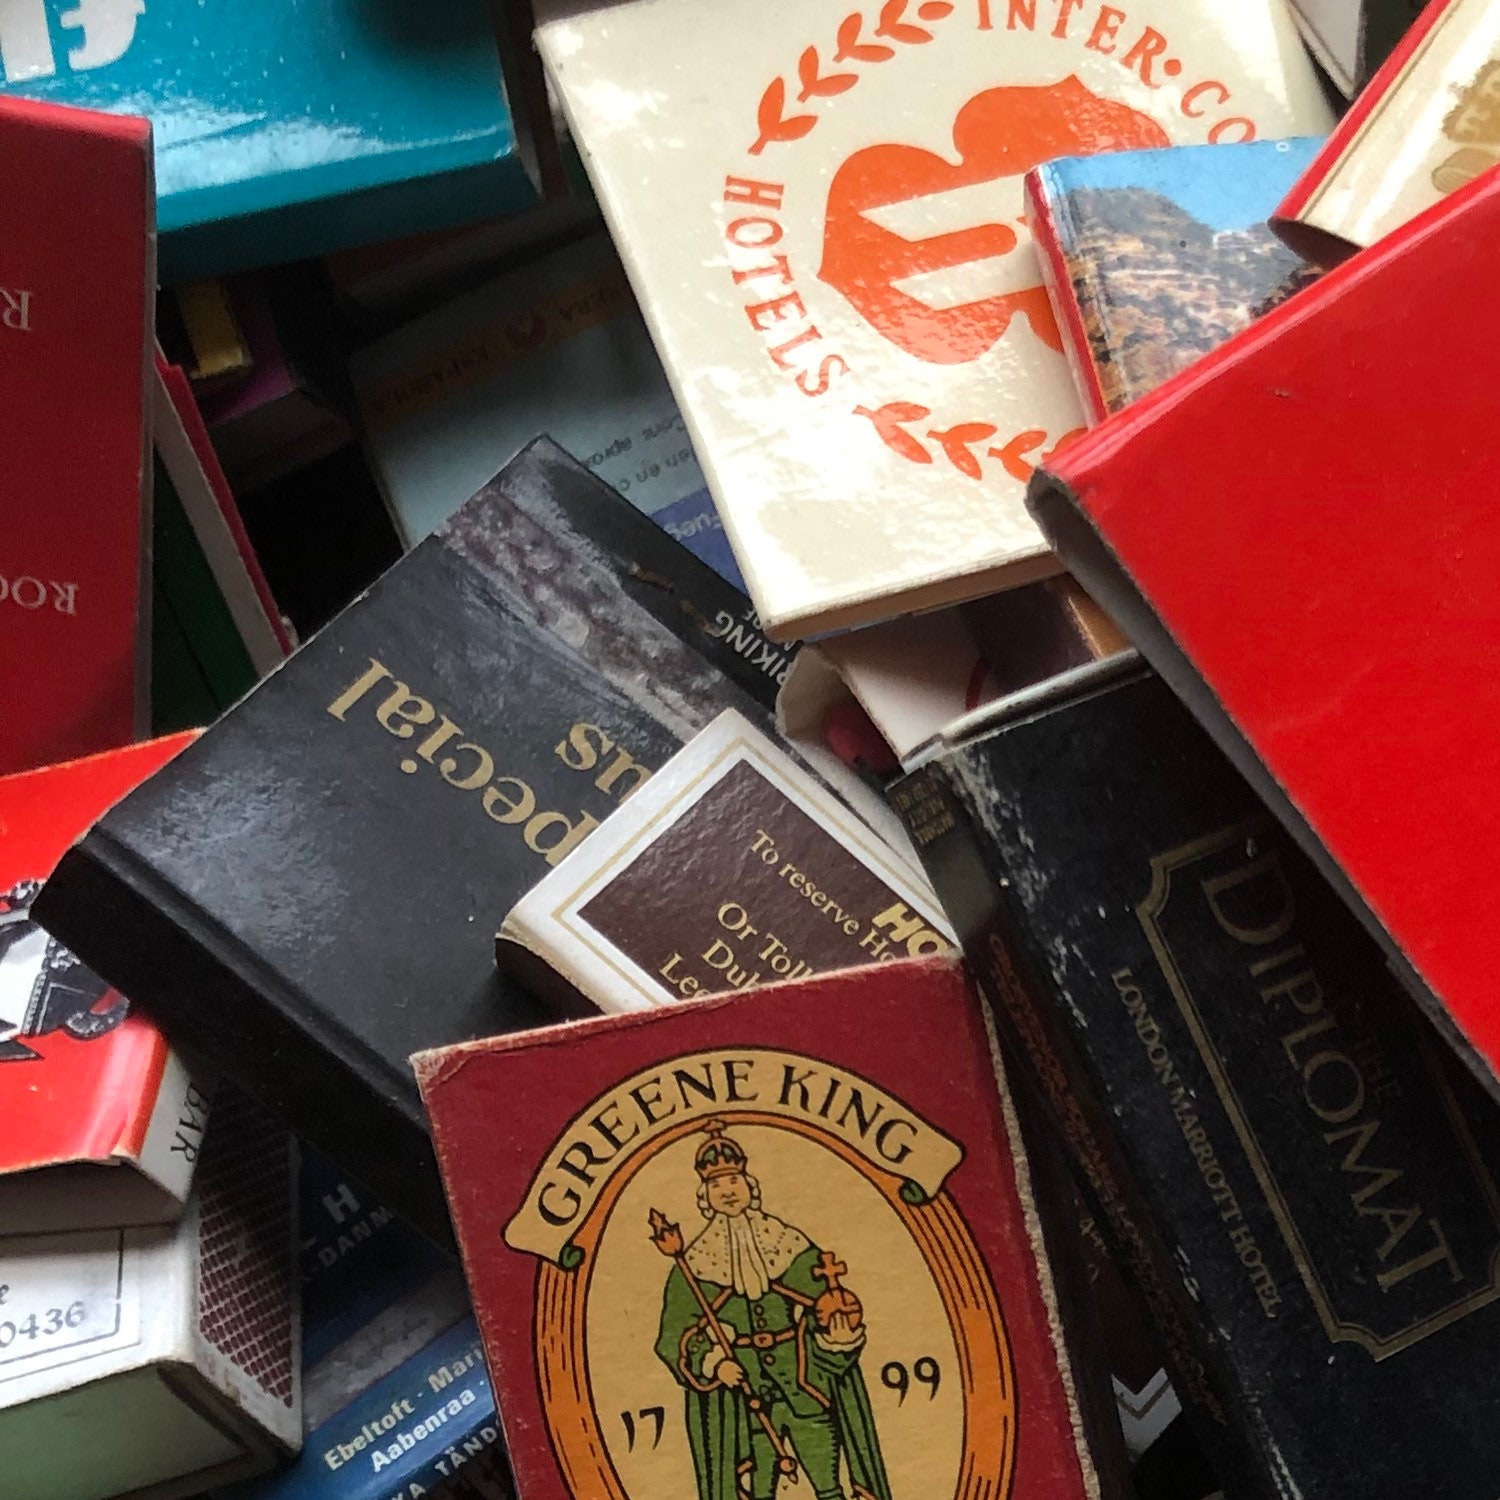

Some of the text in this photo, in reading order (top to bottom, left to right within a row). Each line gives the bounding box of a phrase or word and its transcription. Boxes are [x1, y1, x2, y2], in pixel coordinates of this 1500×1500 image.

[724, 174, 852, 398] HOTELS
[0, 574, 78, 617] RO
[717, 902, 759, 941] Or
[750, 829, 780, 865] To
[779, 863, 861, 936] reserve
[1199, 855, 1463, 1295] DIPLOMAT
[538, 1060, 920, 1228] GREENE KING
[1110, 967, 1284, 1318] LONDON MARRIOTT HOTEL
[880, 1356, 941, 1408] 99
[324, 1398, 415, 1471] Ebeltoft
[371, 1389, 476, 1473] Aabenraa
[621, 1407, 665, 1452] 17
